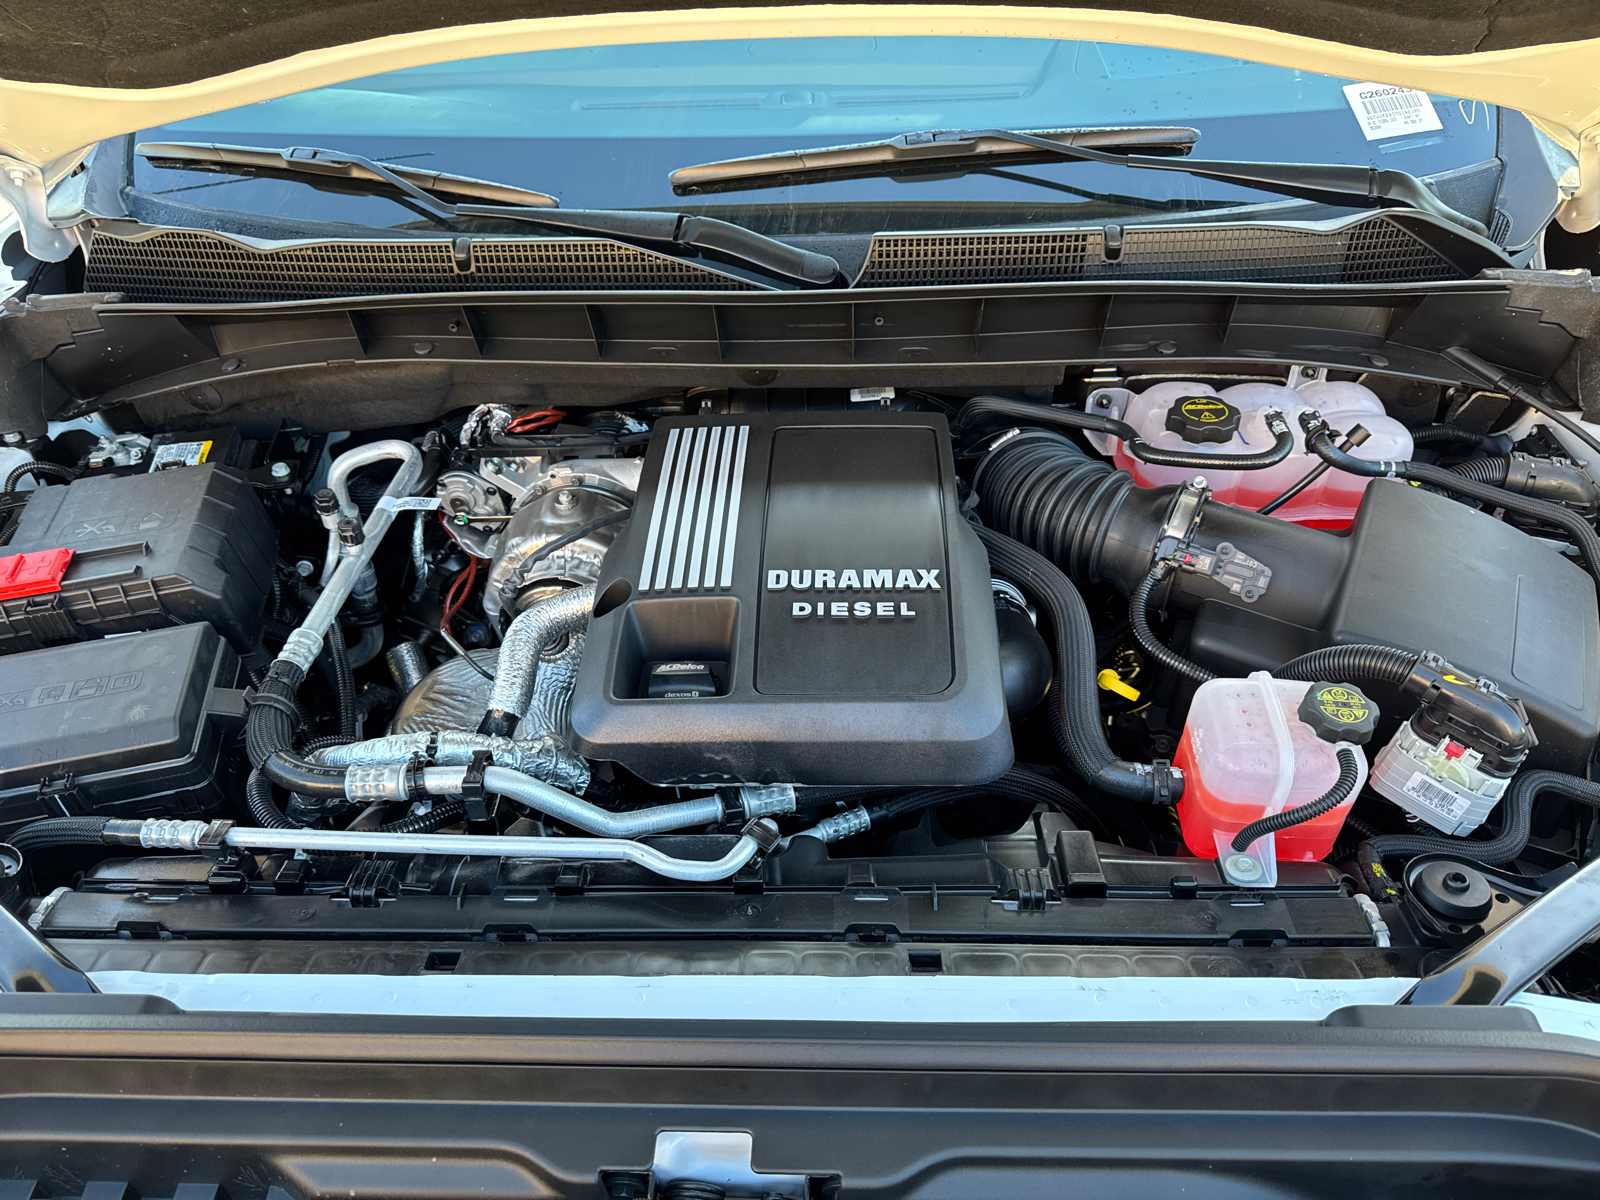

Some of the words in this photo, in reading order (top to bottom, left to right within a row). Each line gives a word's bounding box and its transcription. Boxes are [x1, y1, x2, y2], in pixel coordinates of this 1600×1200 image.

[767, 569, 941, 591] DURAMAX
[792, 602, 916, 619] DIESEL
[655, 663, 705, 672] ACDelco
